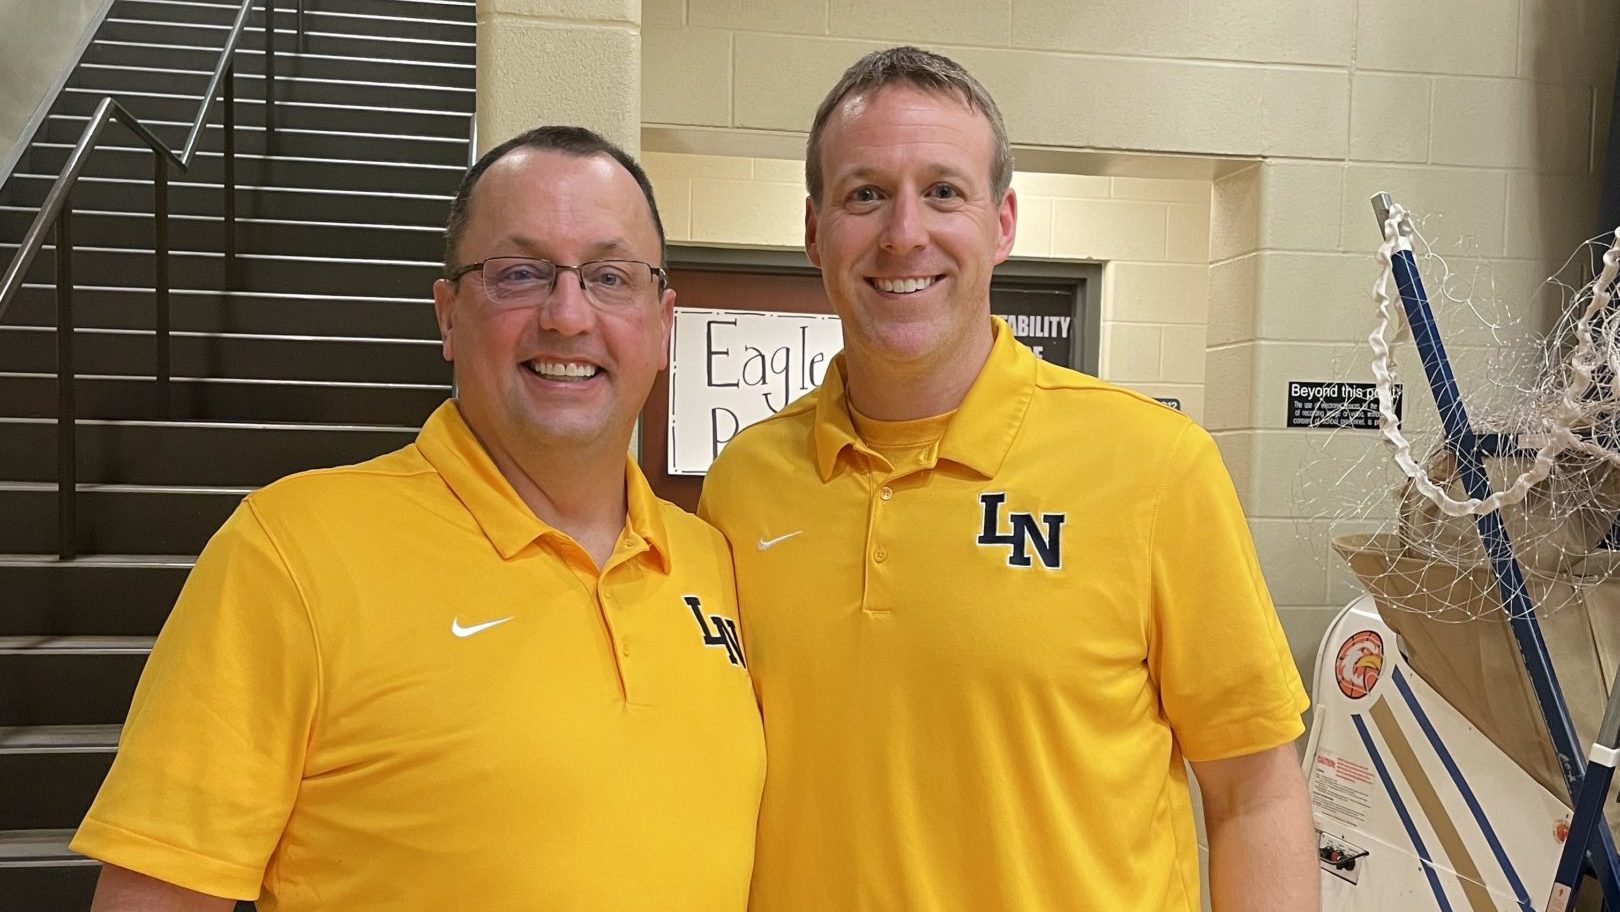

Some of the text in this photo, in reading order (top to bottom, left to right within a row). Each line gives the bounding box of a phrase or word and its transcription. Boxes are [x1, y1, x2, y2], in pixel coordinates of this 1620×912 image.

[1001, 314, 1070, 338] ABILITY
[1291, 383, 1397, 401] Beyond this pot
[976, 492, 1066, 569] LN
[681, 594, 747, 670] LN
